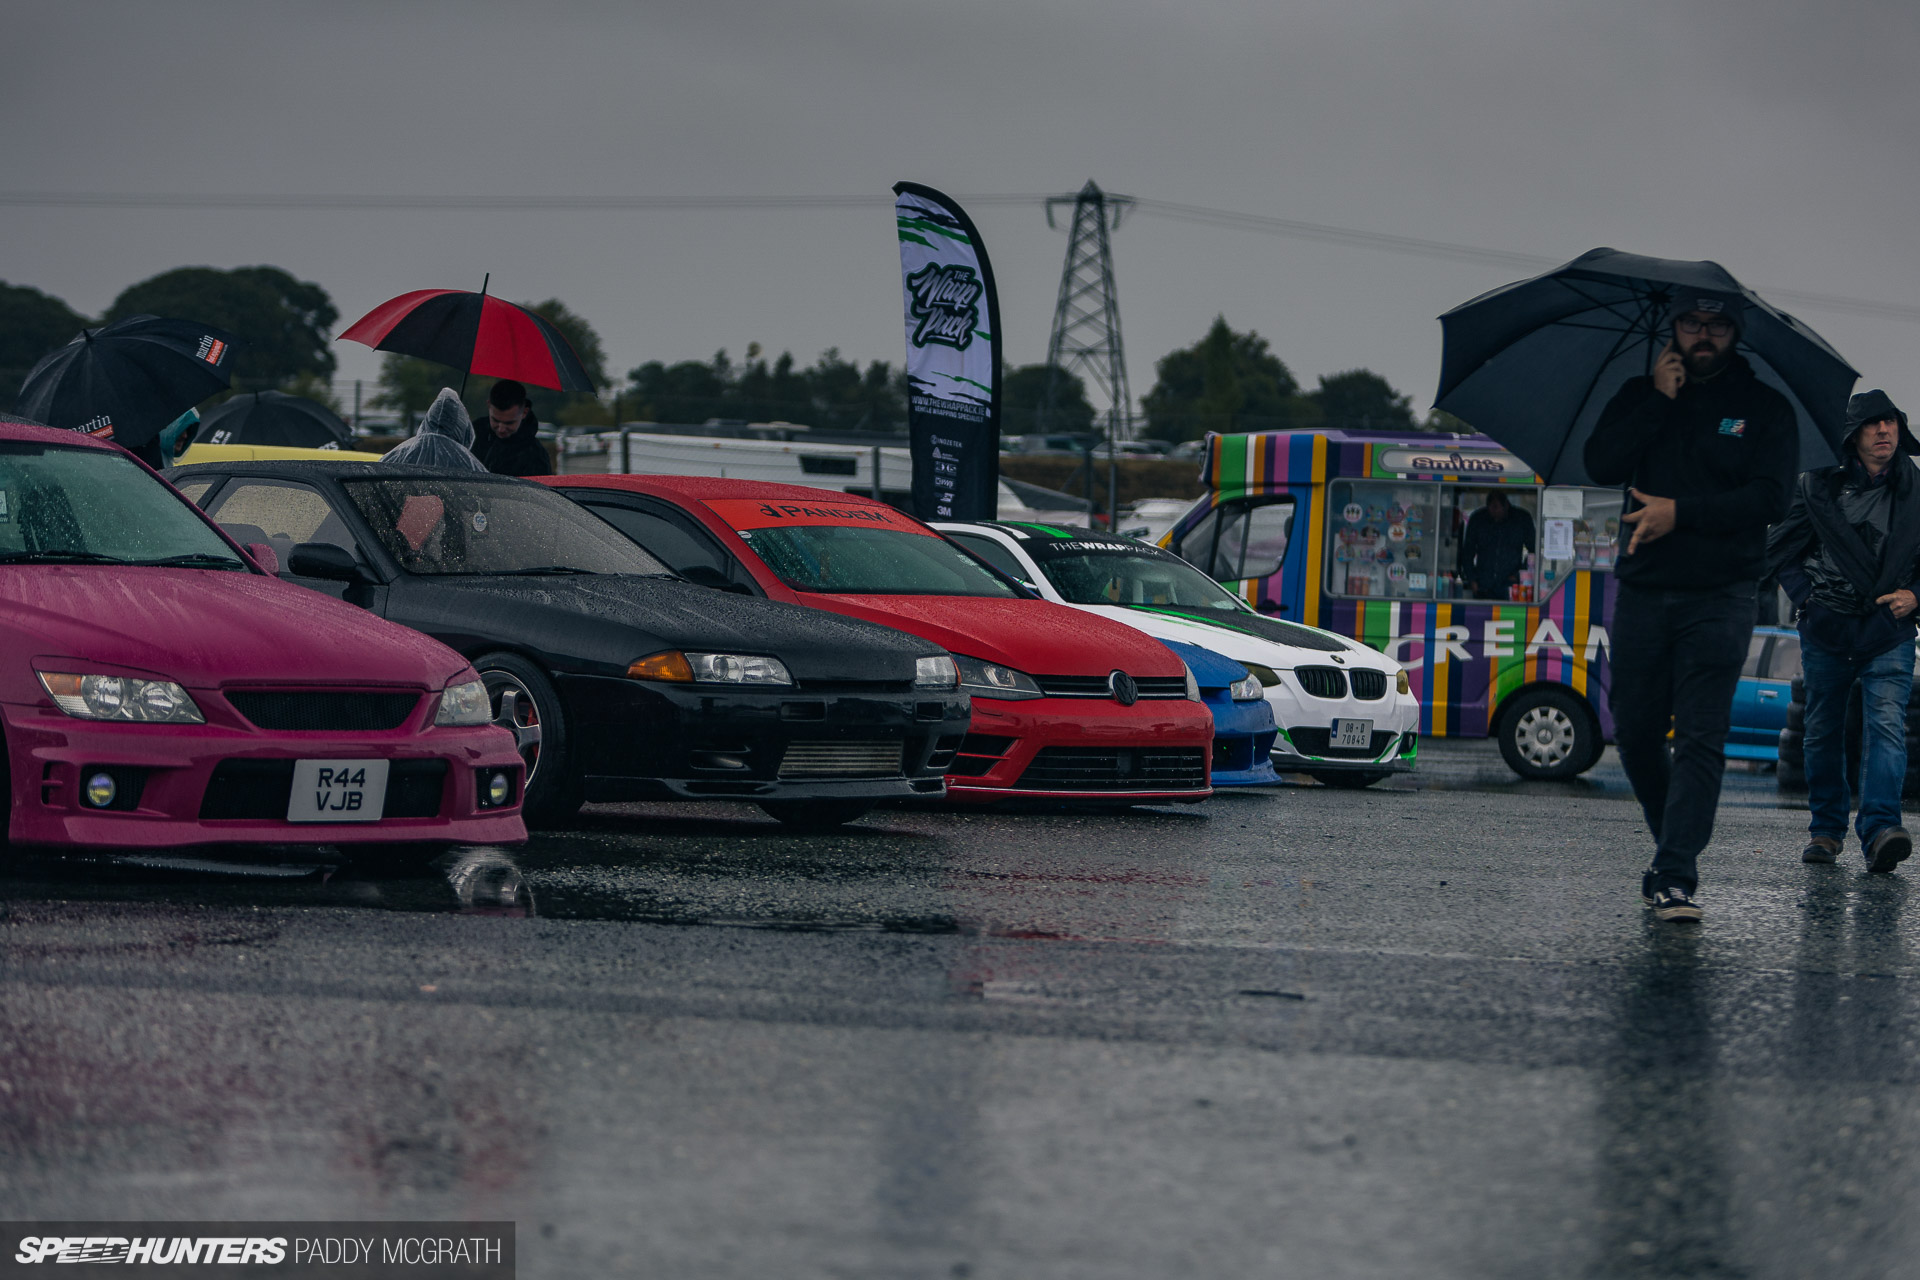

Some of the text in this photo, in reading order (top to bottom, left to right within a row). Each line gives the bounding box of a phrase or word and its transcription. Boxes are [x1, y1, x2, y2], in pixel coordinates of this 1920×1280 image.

[953, 271, 970, 281] THE
[1412, 452, 1504, 472] Smith's
[778, 503, 892, 524] PANDEM
[936, 505, 952, 517] 3M
[1342, 734, 1366, 745] 70845
[318, 768, 365, 788] R44
[316, 791, 363, 810] VJB
